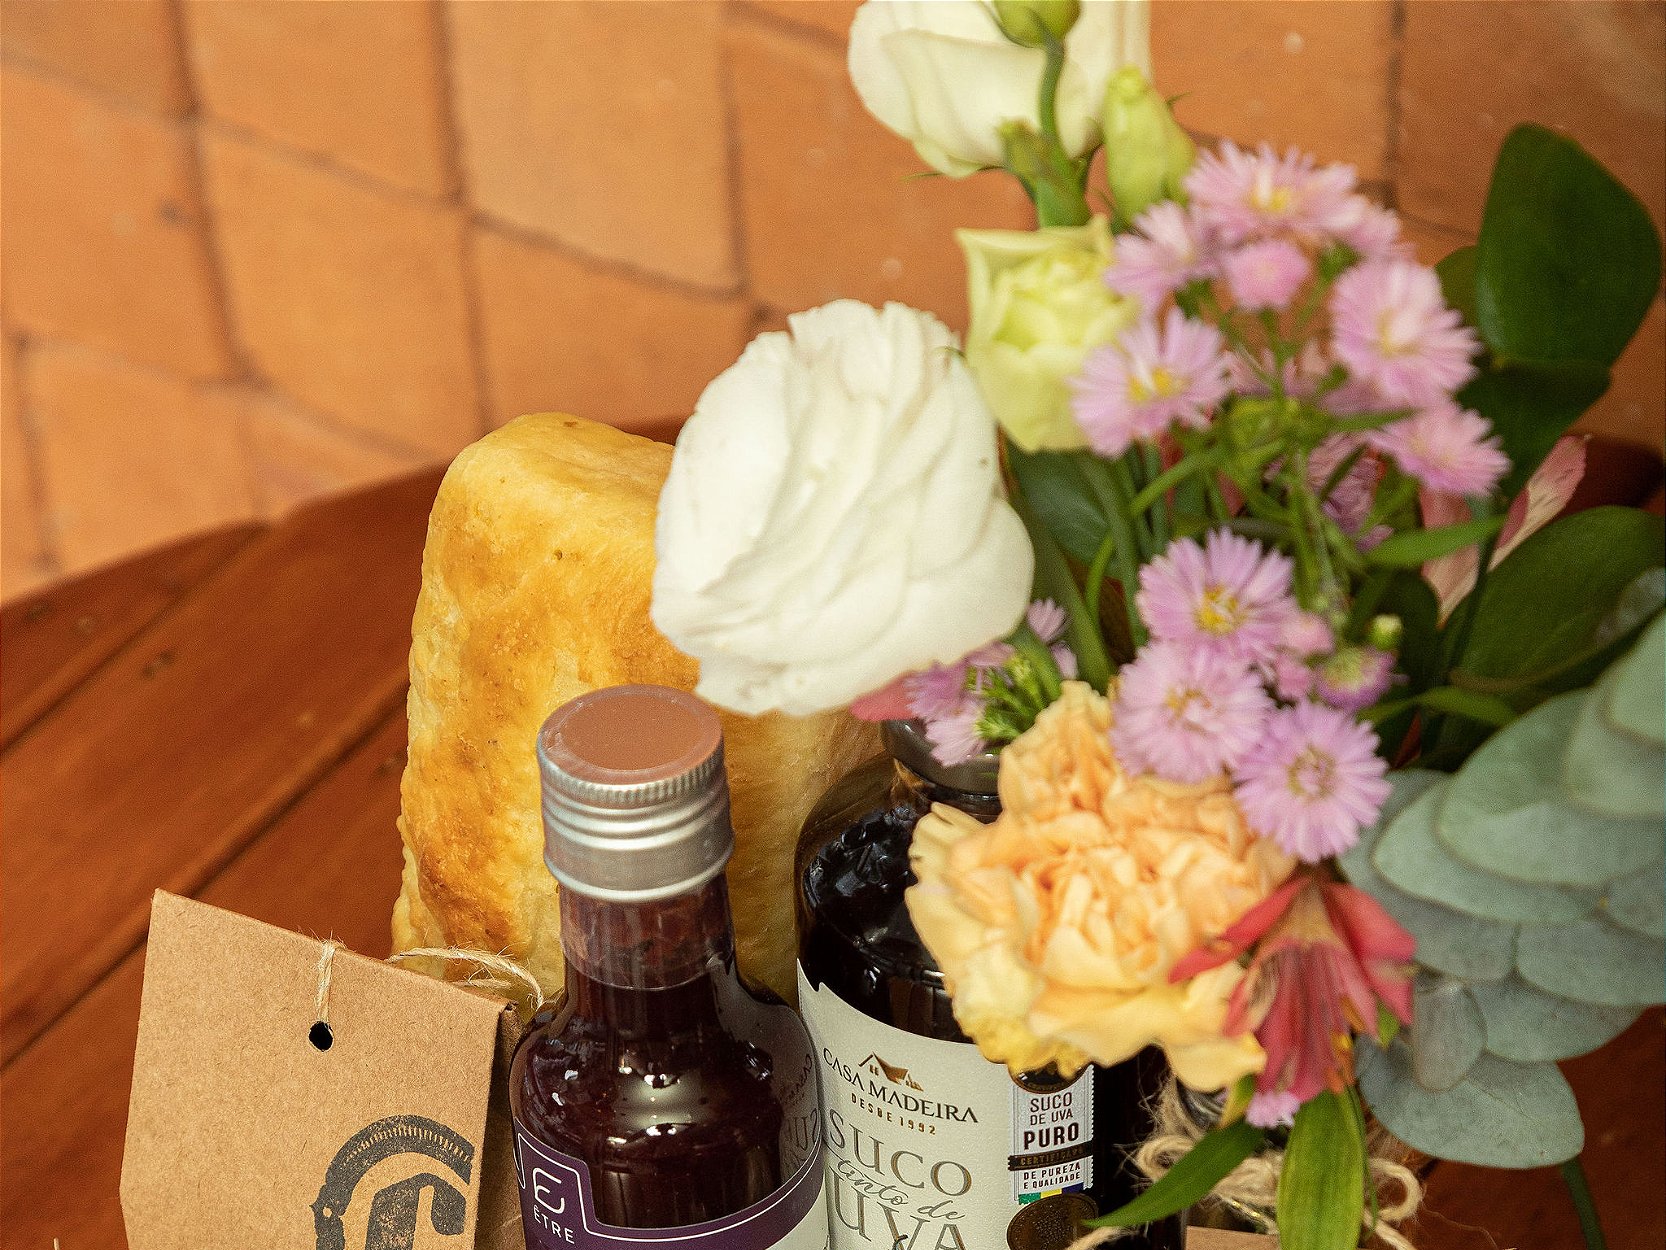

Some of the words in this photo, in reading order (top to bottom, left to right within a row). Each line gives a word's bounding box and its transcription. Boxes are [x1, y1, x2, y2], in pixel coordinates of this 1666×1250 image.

[823, 1047, 865, 1091] CASA
[868, 1079, 979, 1123] MADEIRA
[851, 1092, 893, 1123] DESDE
[899, 1116, 936, 1135] 1992
[1030, 1092, 1073, 1113] SUCO
[1030, 1113, 1046, 1126] DE
[1051, 1108, 1074, 1122] UVA
[1023, 1122, 1080, 1150] PURO
[829, 1108, 972, 1196] SUCO
[1023, 1170, 1037, 1180] DE
[1041, 1161, 1081, 1178] PUREZA
[1032, 1172, 1081, 1189] QUALIDADE
[917, 1199, 966, 1220] de
[533, 1204, 575, 1245] ÊTRE
